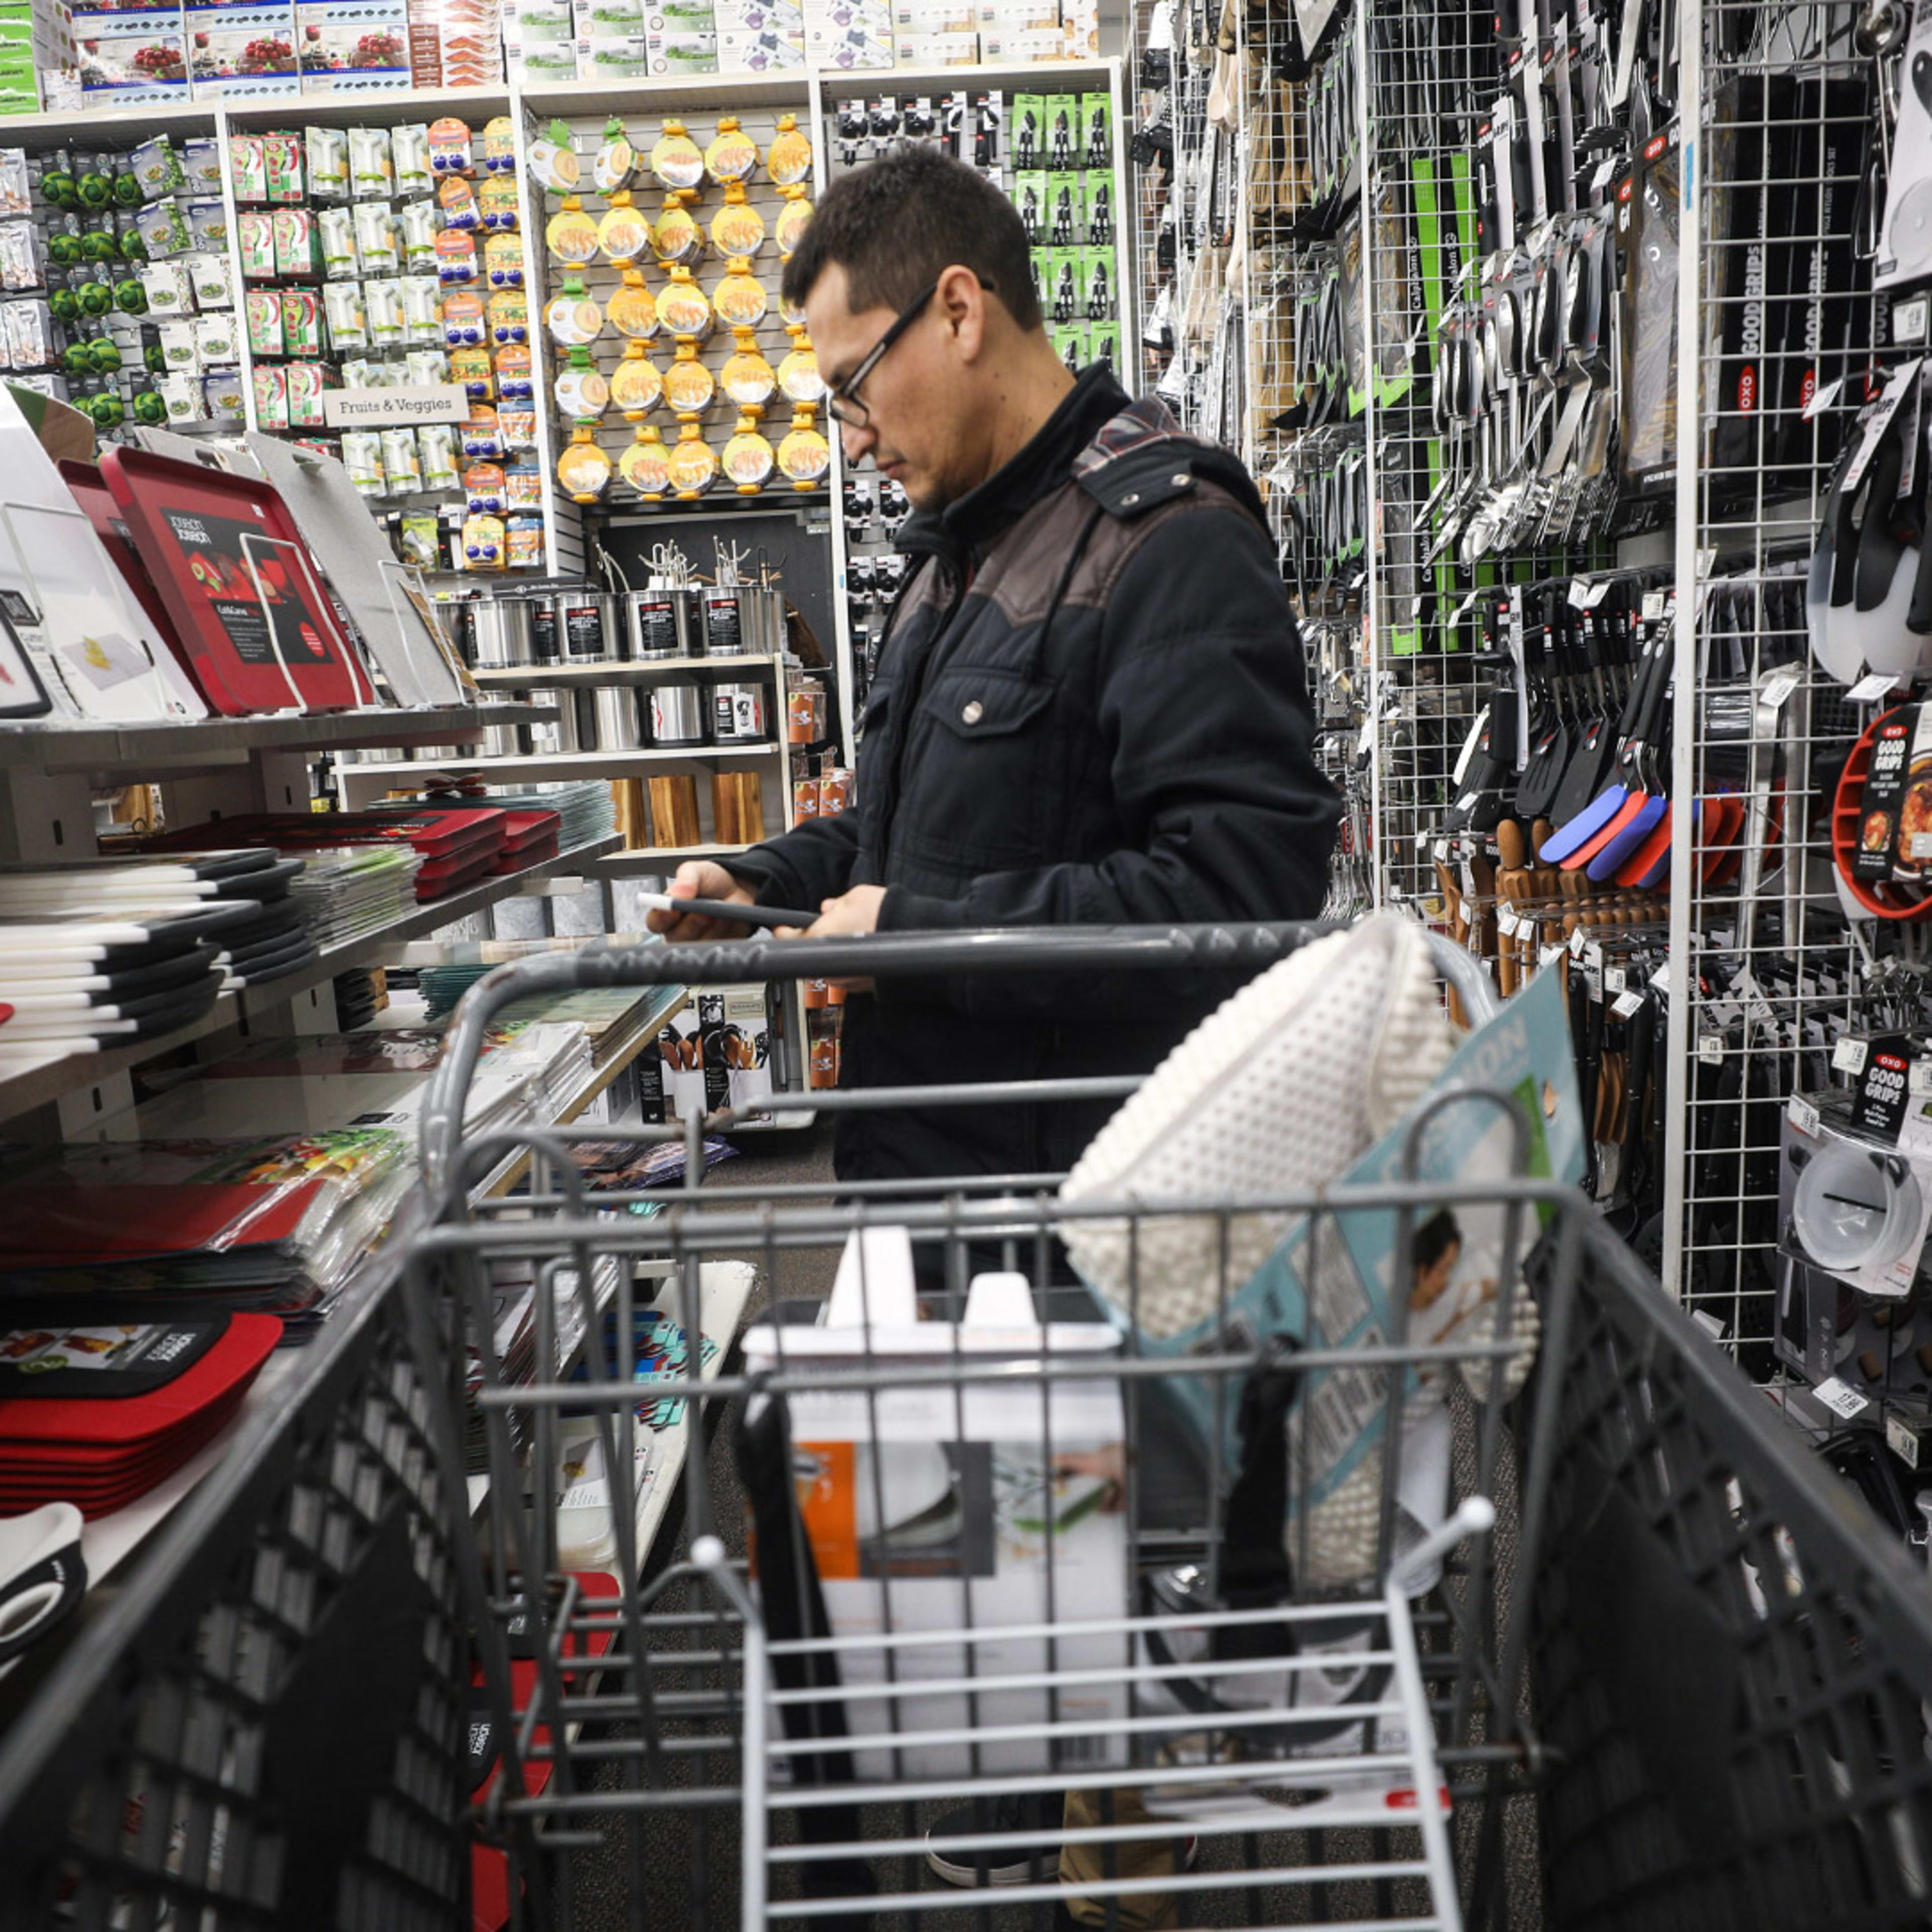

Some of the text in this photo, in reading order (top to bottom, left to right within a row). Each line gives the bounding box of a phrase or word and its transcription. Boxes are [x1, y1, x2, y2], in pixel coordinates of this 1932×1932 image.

[1741, 245, 1761, 355] GOOD GRIPS
[1740, 375, 1753, 410] OXO
[340, 398, 452, 414] Fruits & Veggies
[1877, 740, 1906, 755] GOOD
[1875, 755, 1903, 770] GRIPS
[1881, 1056, 1902, 1069] OXO
[1869, 1066, 1904, 1090] GOOD
[1865, 1082, 1901, 1104] GRIPS
